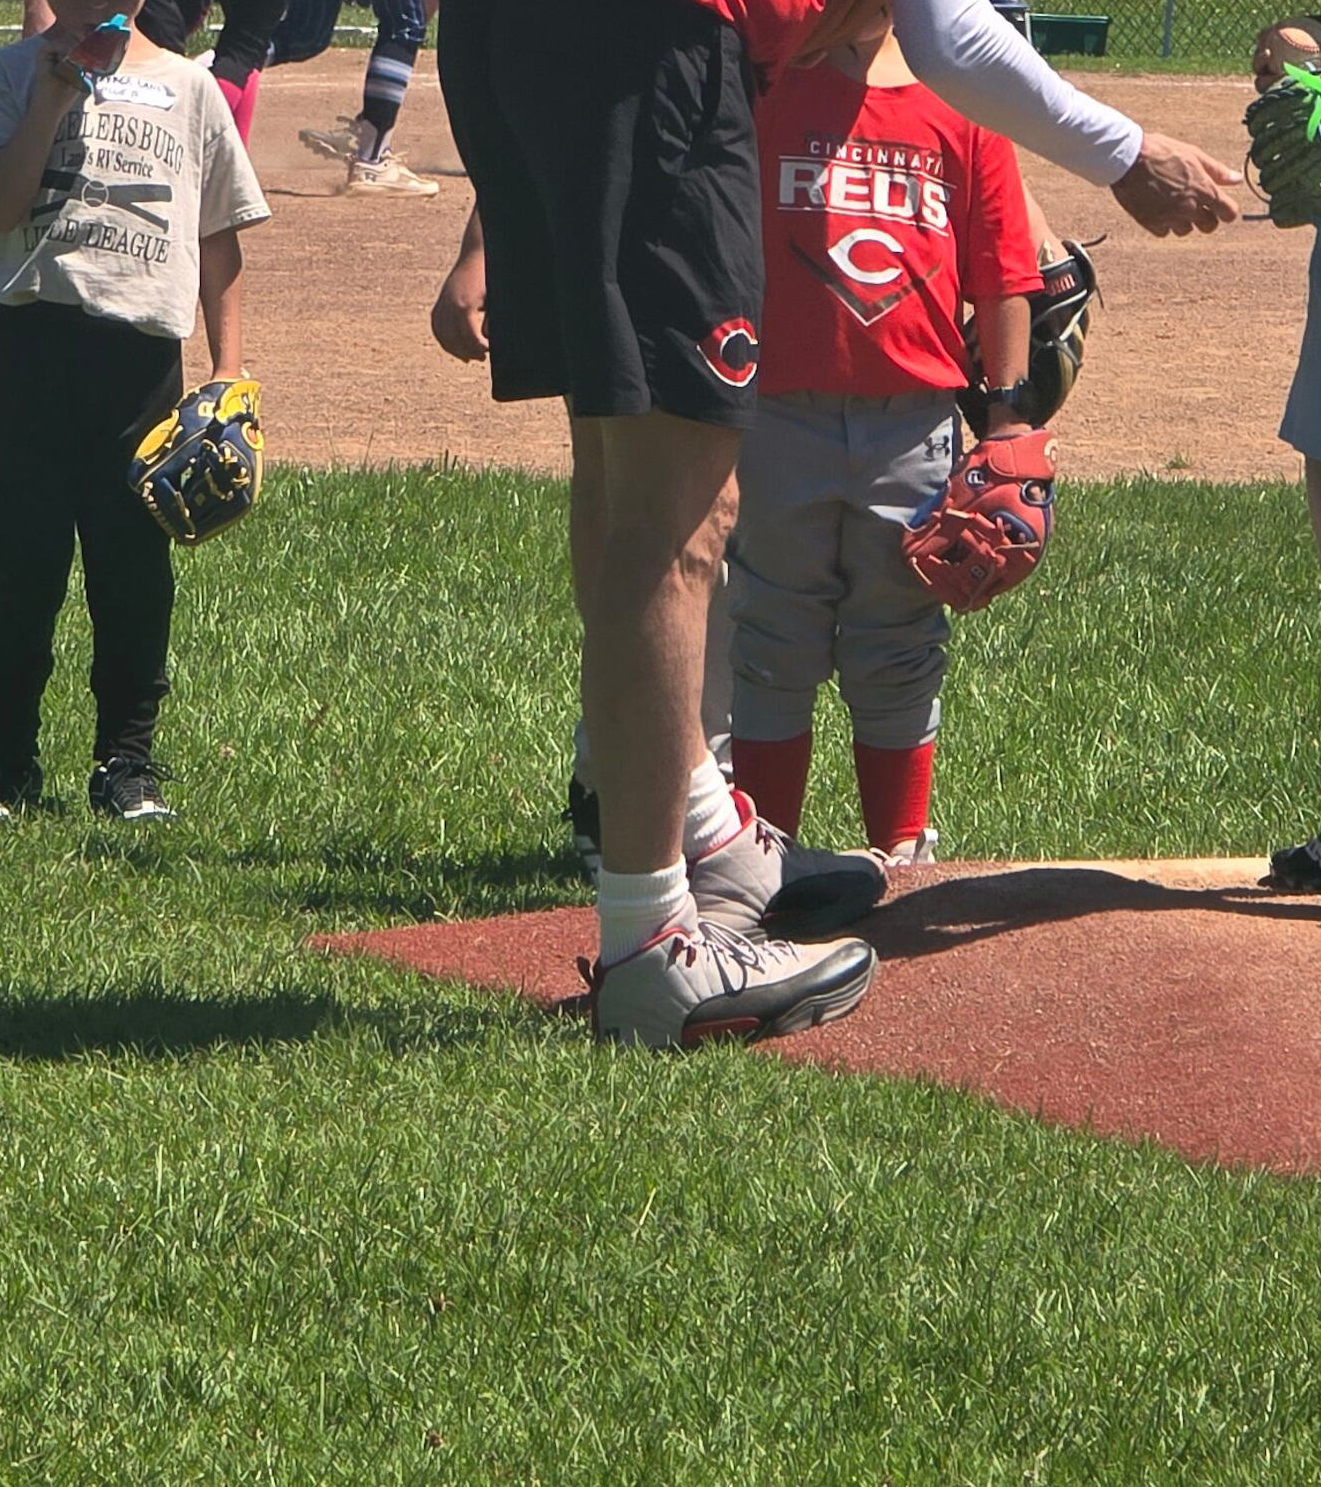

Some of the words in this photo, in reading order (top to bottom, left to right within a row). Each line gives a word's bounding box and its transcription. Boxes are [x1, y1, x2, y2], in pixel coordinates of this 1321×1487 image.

[96, 148, 115, 170] RV
[114, 152, 154, 179] Service
[809, 140, 943, 176] CINCINNATI
[779, 161, 950, 229] REDS
[83, 221, 171, 264] LEAGUE
[828, 227, 905, 285] C
